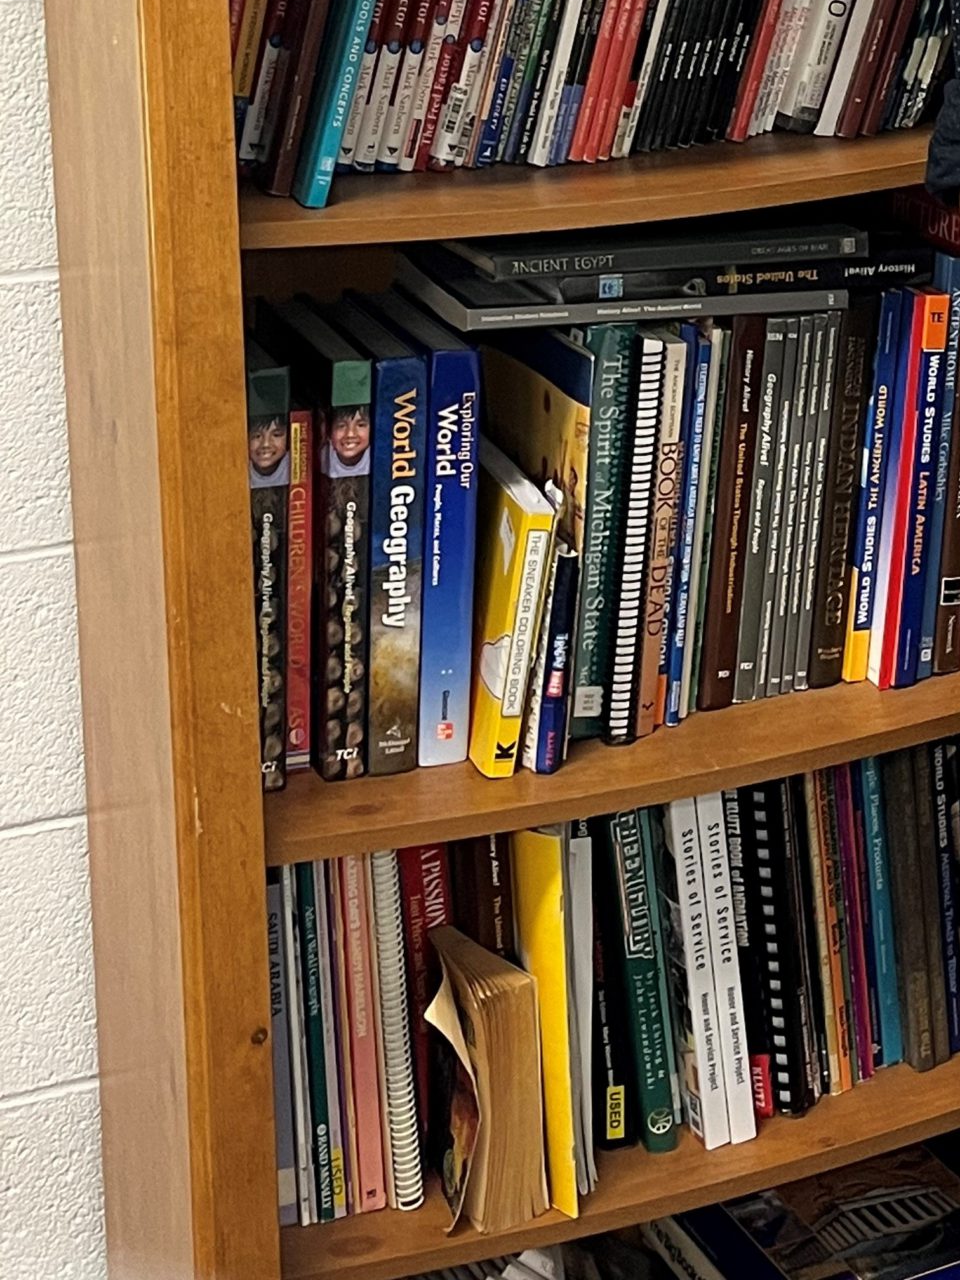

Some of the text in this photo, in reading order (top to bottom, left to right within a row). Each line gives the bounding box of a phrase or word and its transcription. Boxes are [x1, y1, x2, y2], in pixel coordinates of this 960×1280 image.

[349, 36, 362, 63] AND
[332, 67, 354, 128] CONCEPTS
[421, 52, 452, 145] The Fred Factor
[511, 255, 615, 275] ANCIENT EGYPT
[716, 269, 818, 286] The United States
[844, 263, 916, 278] History Alive!
[930, 312, 944, 323] TE
[600, 355, 622, 398] The
[945, 354, 957, 391] ROME
[436, 403, 459, 477] World
[457, 391, 476, 489] Exploring Our
[594, 404, 624, 465] Spirit
[734, 422, 748, 508] The United States
[911, 354, 940, 575] WORLD STUDIES LATIN AMERICA
[381, 388, 417, 628] World Geography
[856, 384, 888, 625] WORLD STUDIES THE ANCIENT WORLD
[585, 489, 614, 589] Michigan
[647, 442, 679, 637] BOOK OF THE DEAD
[503, 534, 542, 711] THE SNEAKER COLORING BOOK
[581, 596, 606, 651] State
[933, 745, 948, 849] WORLD STUDIES
[422, 860, 447, 929] PASSION
[873, 837, 883, 891] Products
[267, 912, 282, 1017] SAUDI ARABIA
[681, 828, 719, 1092] Stories of Service Service Project
[707, 822, 745, 1086] Stories of Service Service Project
[609, 1091, 621, 1129] USED
[751, 1066, 766, 1109] KLUTZ
[318, 1135, 328, 1165] RAND
[331, 1156, 344, 1196] USED
